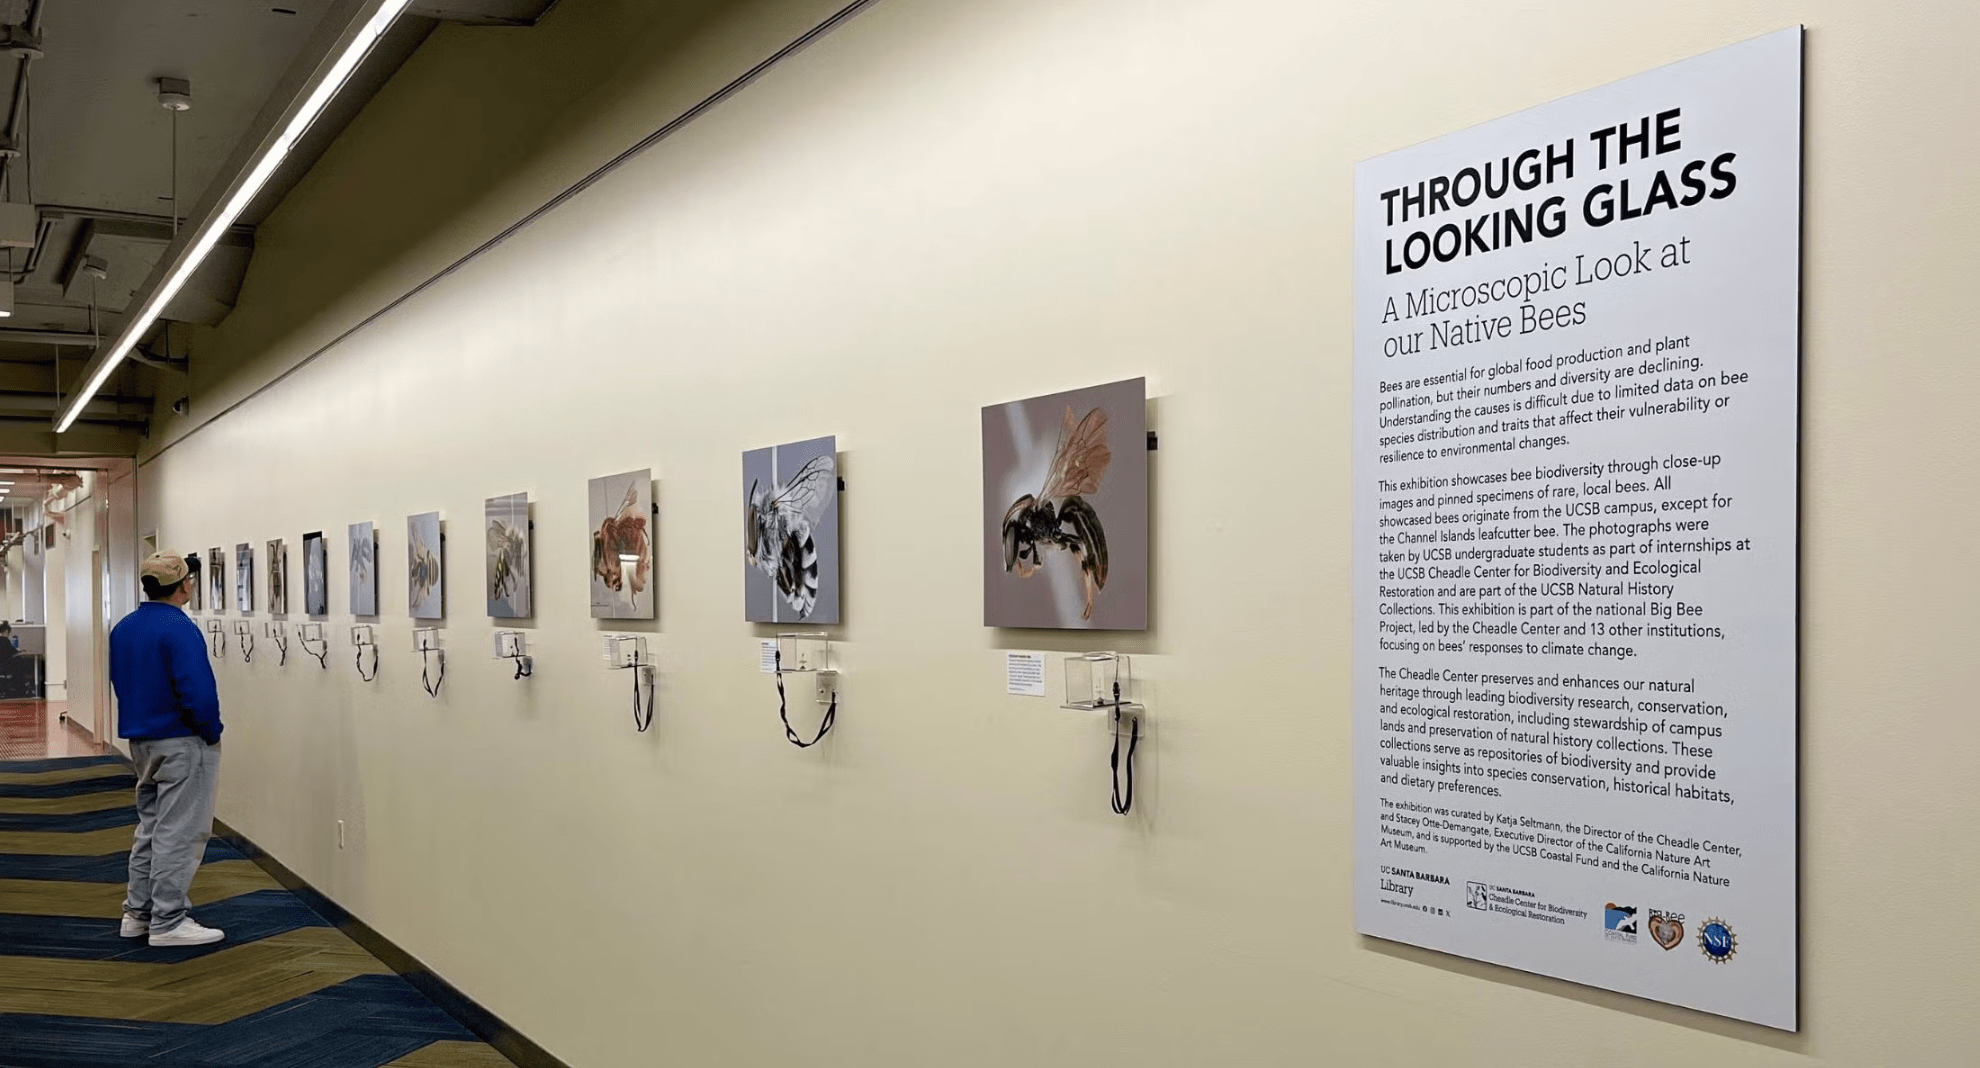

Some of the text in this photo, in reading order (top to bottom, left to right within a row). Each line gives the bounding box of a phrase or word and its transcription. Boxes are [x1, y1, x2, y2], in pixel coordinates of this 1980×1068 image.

[1380, 107, 1681, 227] THROUGH THE
[1386, 152, 1737, 276] LOOKING GLASS
[1381, 236, 1690, 324] A Microscopic Look at
[1384, 301, 1586, 358] our Native Bees
[1380, 335, 1690, 394] Bees are essential for global food production and plant
[1379, 370, 1748, 429] Understanding the causes is difficult due to limited data on bee
[1380, 355, 1704, 413] pollination, but their numbers and diversity are declining.
[1380, 435, 1570, 464] resilience to environmental changes.
[1378, 454, 1721, 492] This exhibition showcases bee biodiversity through close-up
[1379, 475, 1671, 512] images and pinned specimens of rare, local bees. All
[1379, 620, 1724, 640] Project, led by the Cheadle Center and 13 other institutions,
[1378, 666, 1694, 693] The Cheadle Center preserves and enhances our natural
[1380, 683, 1727, 719] heritage through leading biodiversity research, conservation,
[1380, 754, 1734, 806] valuable insights into species conservation, historical habitats,
[1380, 772, 1502, 797] and dietary preferences.
[1380, 797, 1741, 858] The exhibition was curated by Katja Seltmann, the Director of the Cheadle Center,
[1380, 812, 1711, 868] and Stacey Otte-Demangate, Executive Director of the California Nature Art
[1380, 838, 1427, 854] Art Museum.
[1381, 824, 1730, 887] Museum, and is supported by the UCSB Coastal Fund and the California Nature
[1380, 865, 1450, 886] UC SANTA BARBARA
[1380, 878, 1414, 898] Library
[1496, 886, 1512, 894] SANTA
[1513, 889, 1535, 898] BARBARA
[1489, 893, 1588, 920] Cheadle Center for Biodiversity
[1495, 904, 1527, 918] Ecological
[1528, 911, 1565, 925] Restoration
[1704, 932, 1730, 948] NSF
